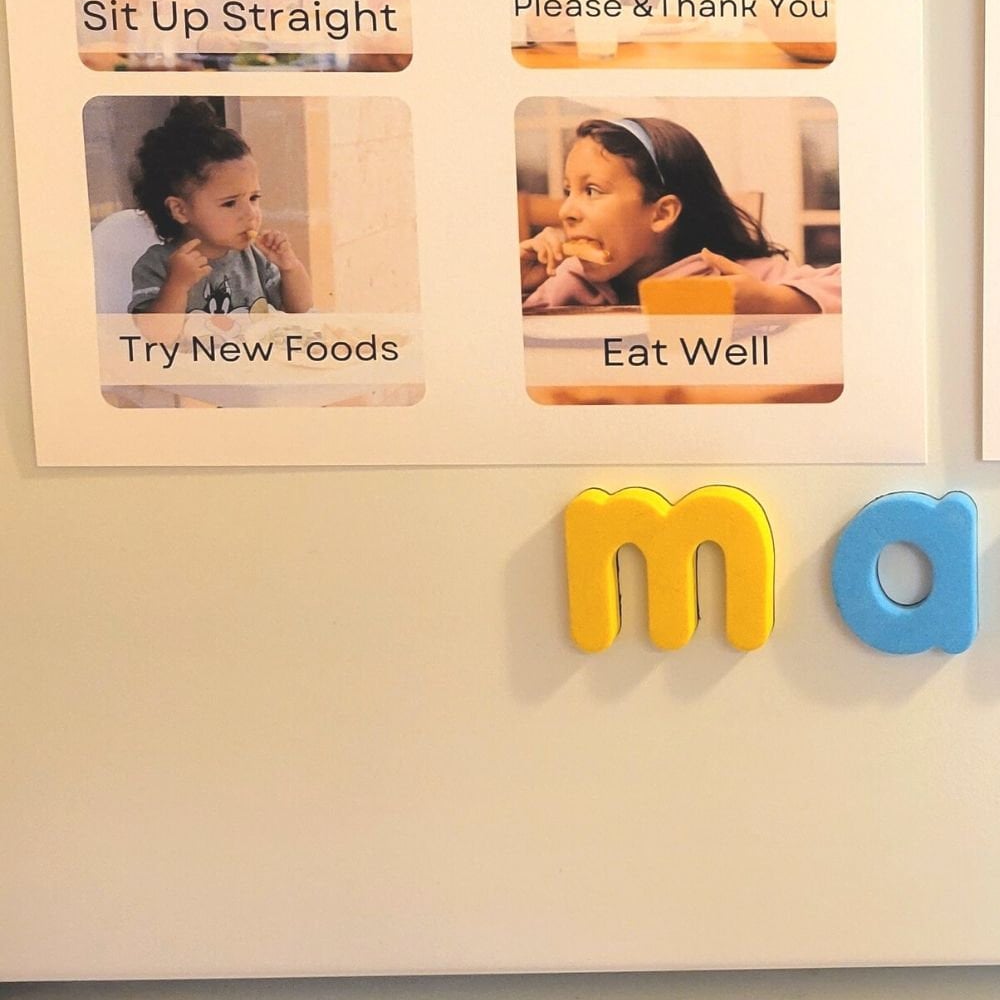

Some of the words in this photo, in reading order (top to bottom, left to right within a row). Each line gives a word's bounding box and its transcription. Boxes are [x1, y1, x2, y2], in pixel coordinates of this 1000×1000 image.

[83, 0, 138, 31] Sit
[152, 0, 209, 39] Up
[222, 0, 398, 40] Straight
[119, 336, 180, 369] Try
[192, 335, 274, 362] New
[286, 334, 399, 362] Foods
[604, 337, 668, 367] Eat
[679, 335, 768, 366] Well
